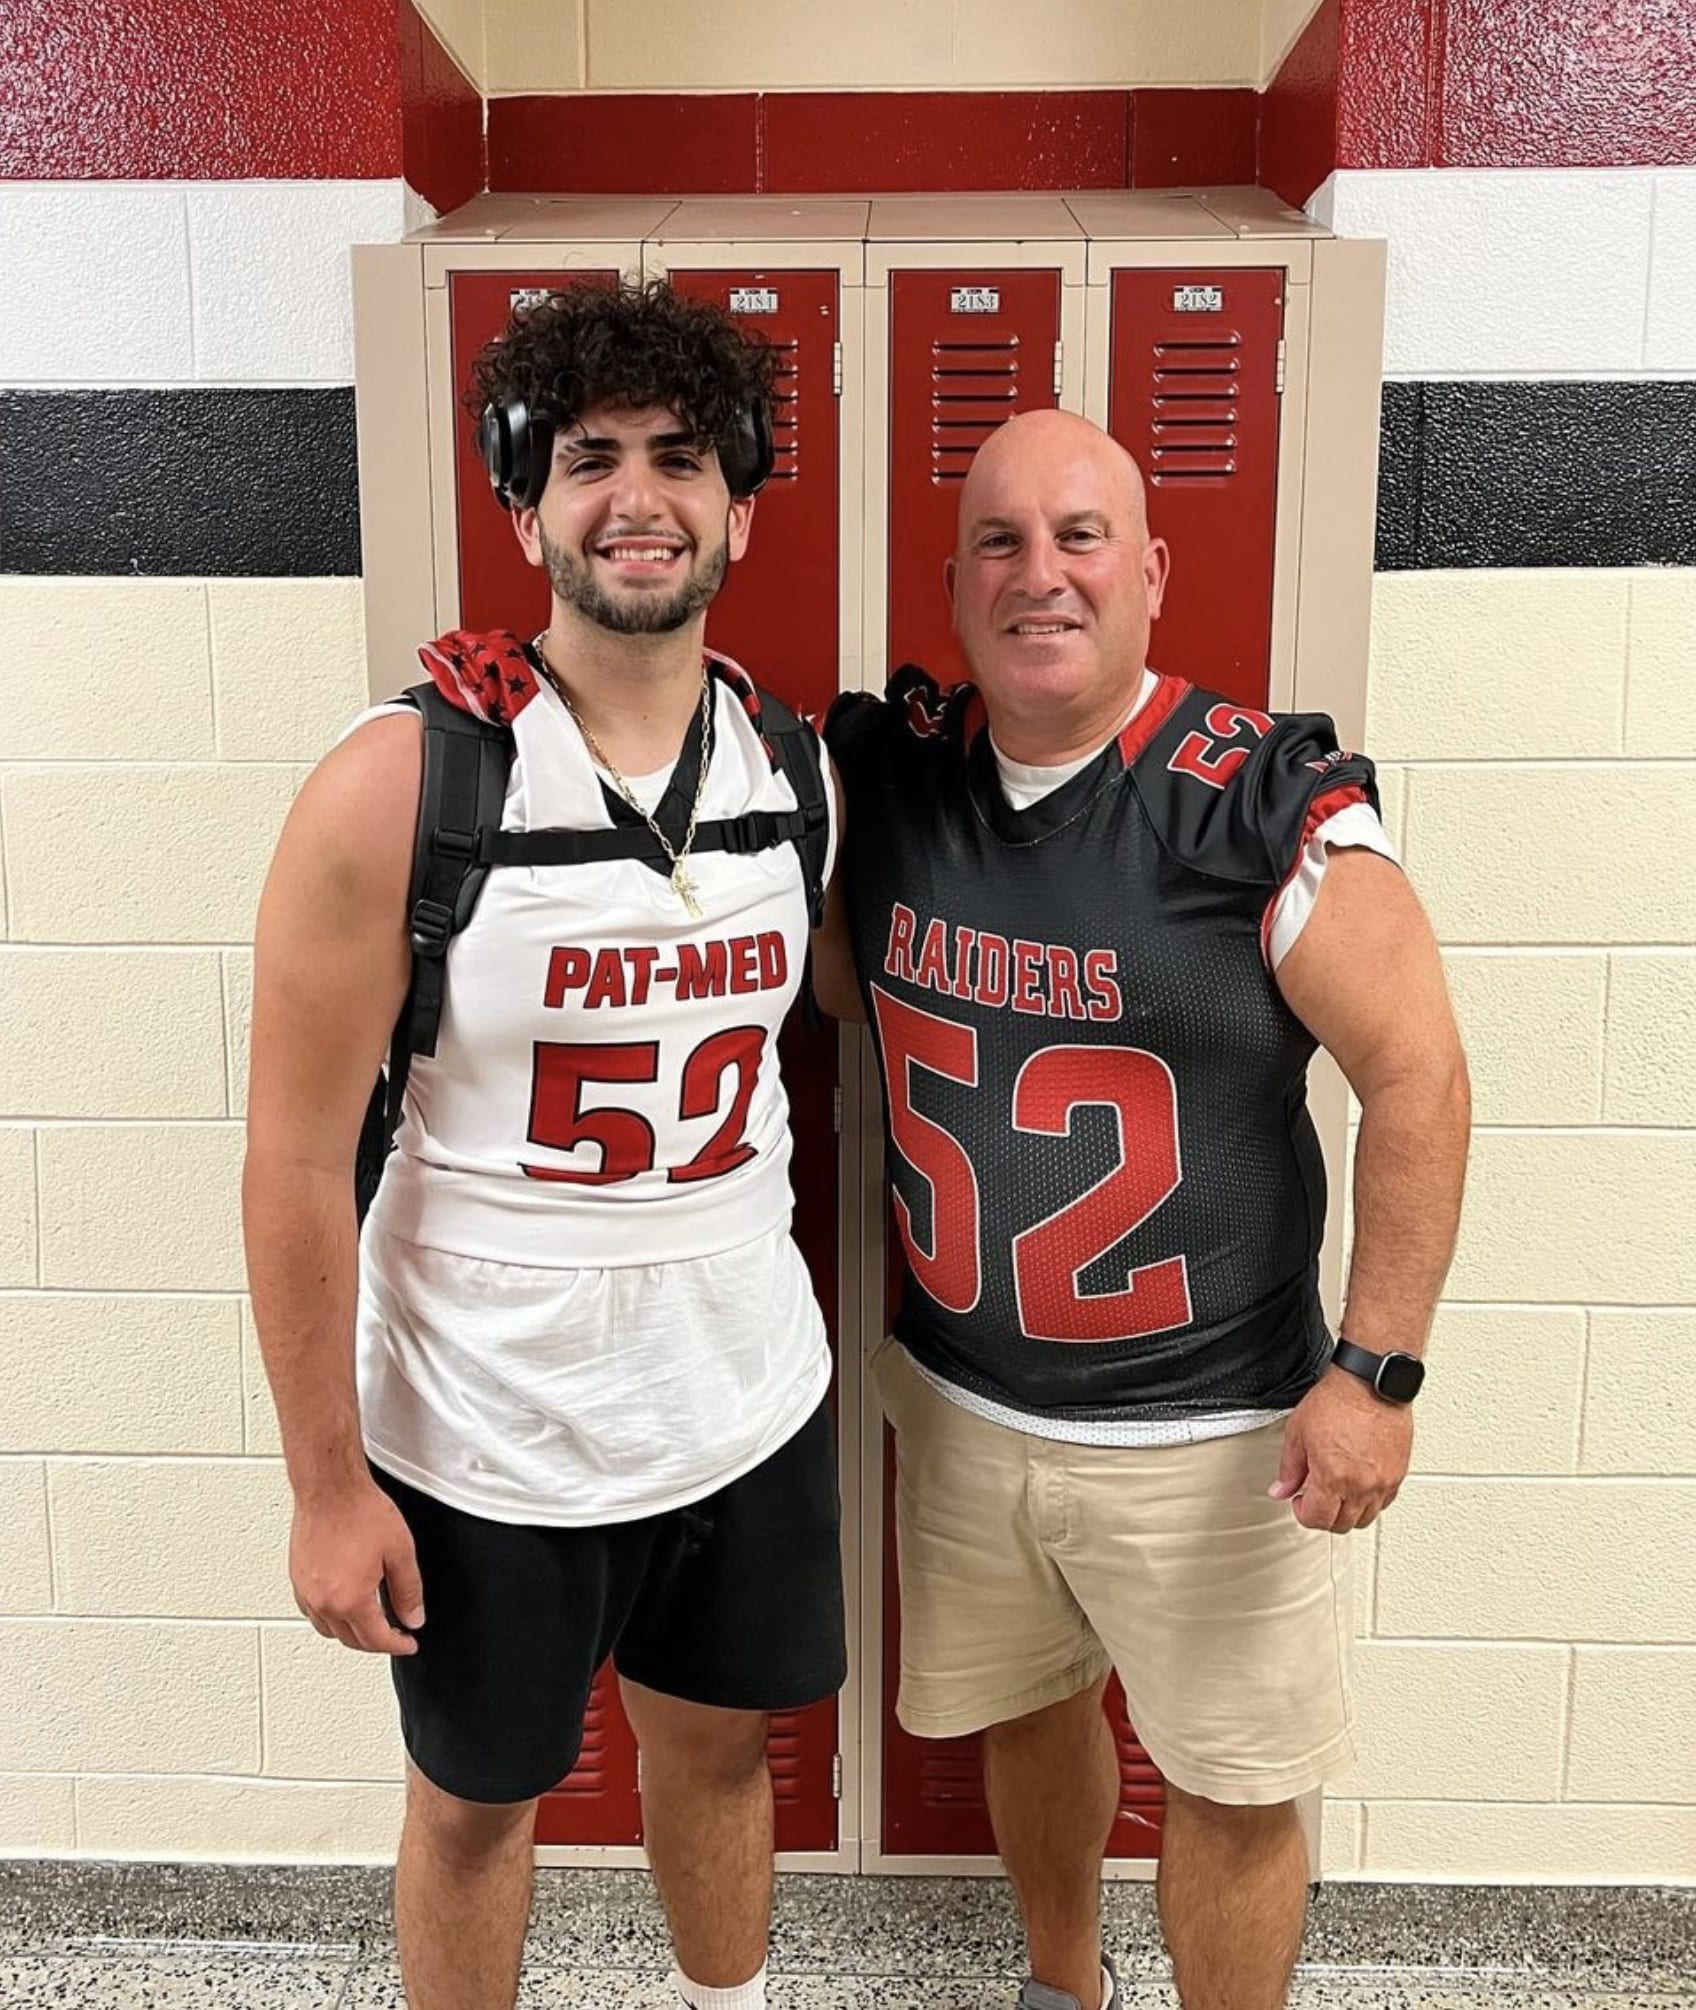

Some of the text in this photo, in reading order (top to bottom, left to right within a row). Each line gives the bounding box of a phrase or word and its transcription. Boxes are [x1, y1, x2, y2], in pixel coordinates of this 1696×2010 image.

[1180, 293, 1217, 308] 2182
[544, 931, 787, 1009] PAT-MED
[884, 902, 1122, 1022] RAIDERS
[518, 1025, 768, 1185] 52
[870, 981, 1193, 1343] 52
